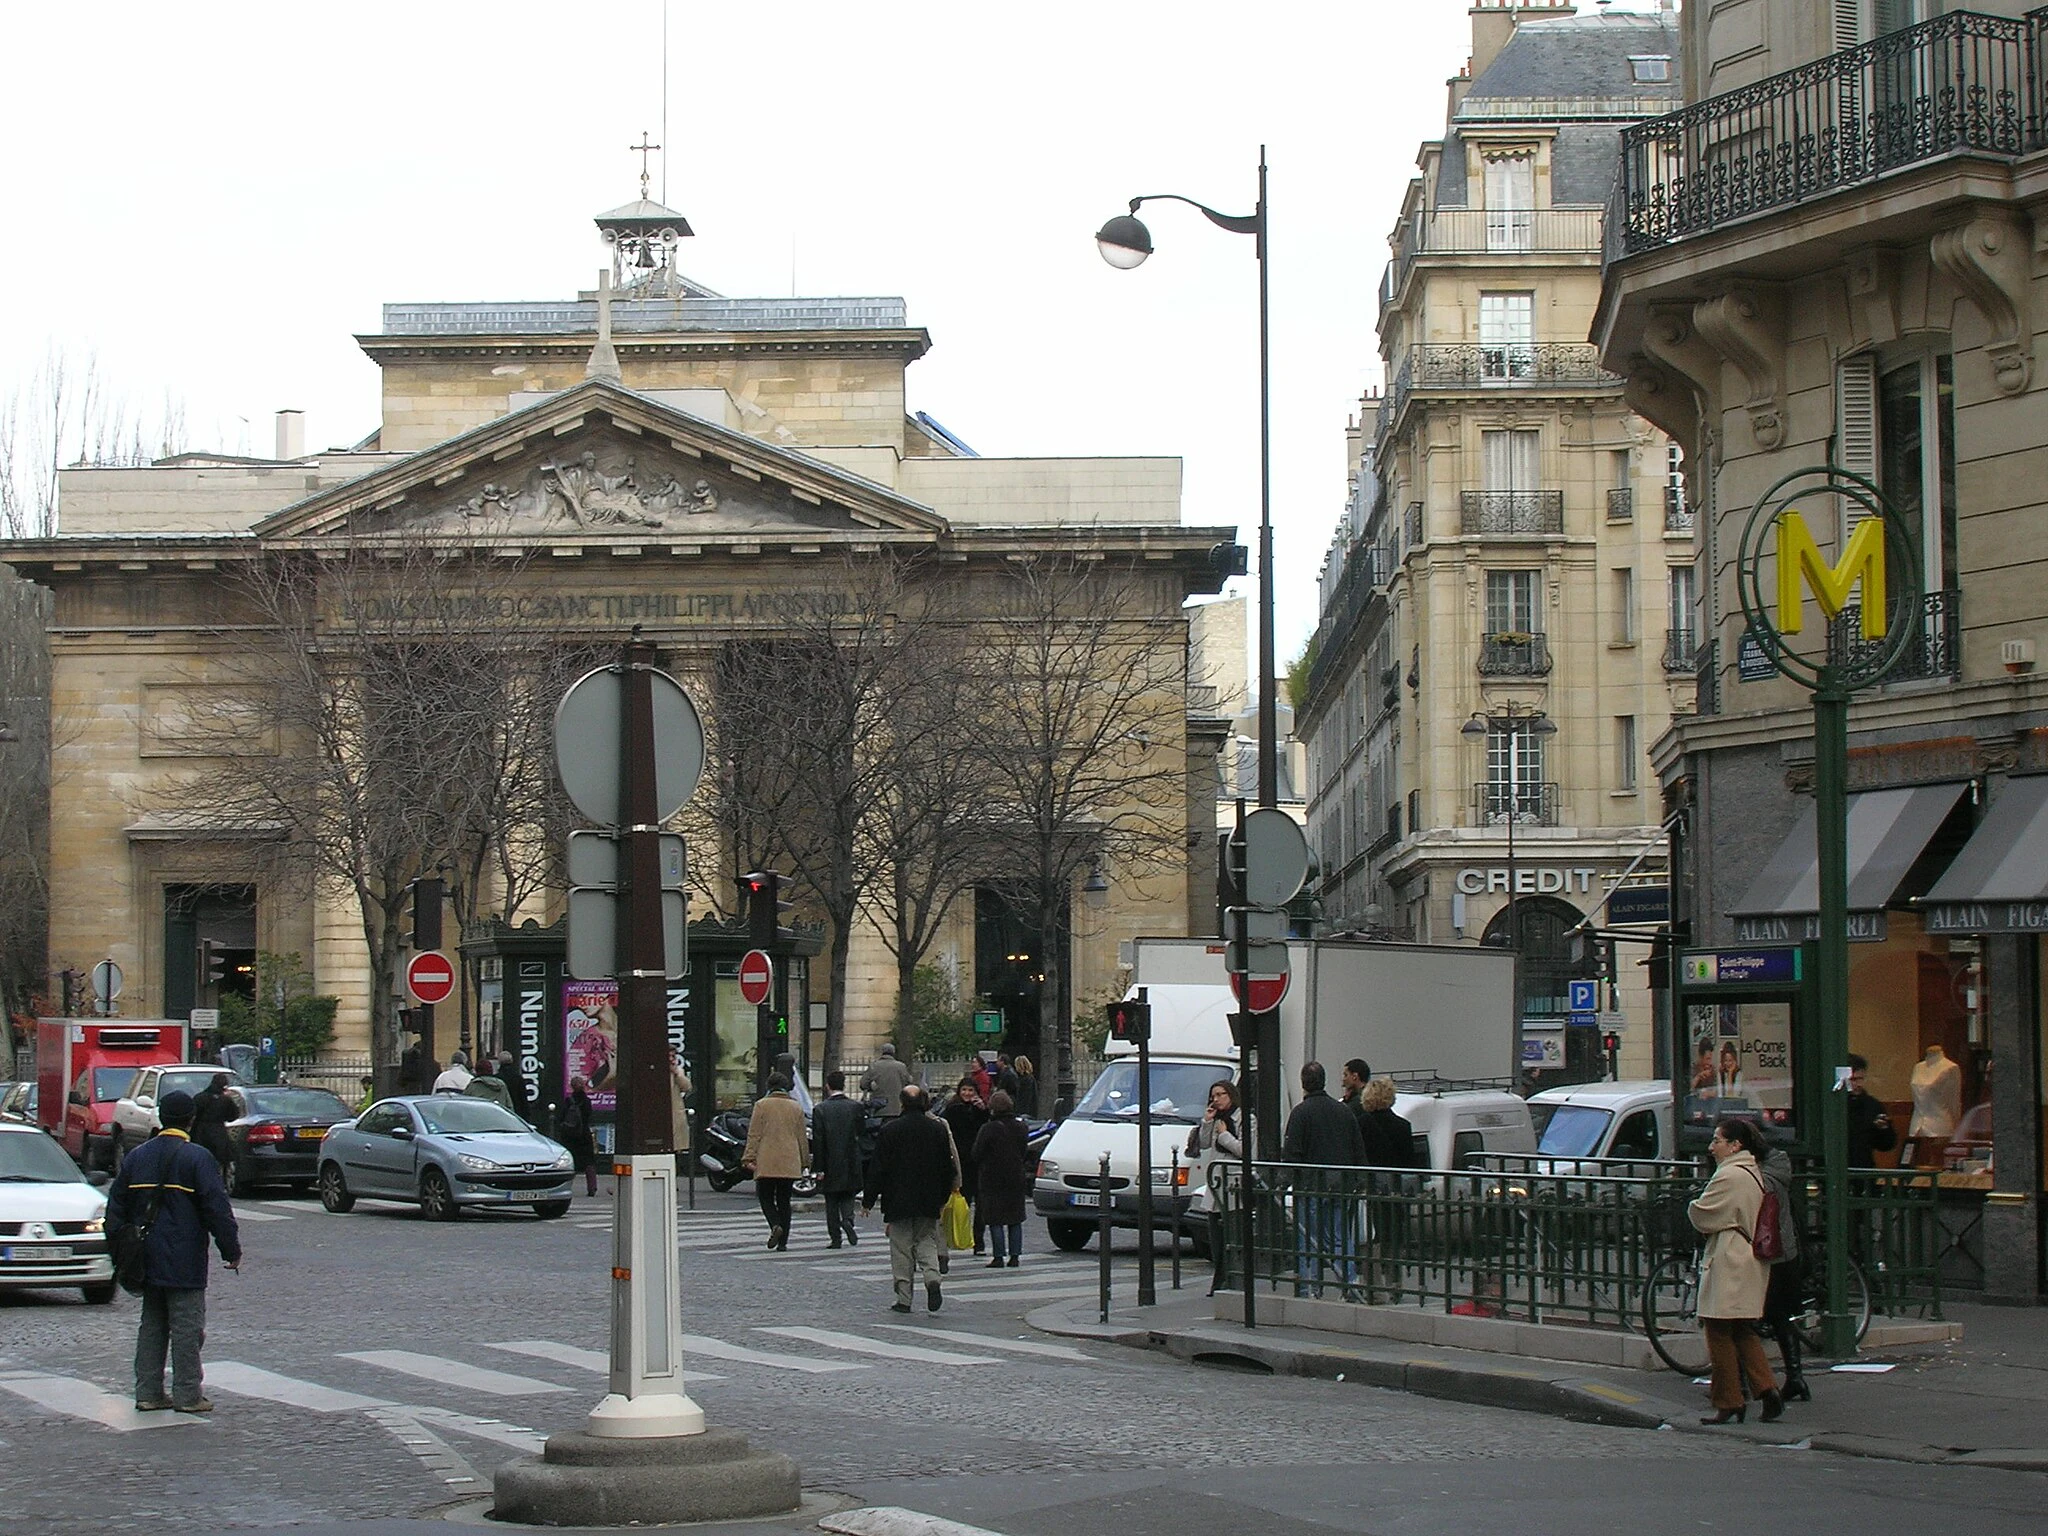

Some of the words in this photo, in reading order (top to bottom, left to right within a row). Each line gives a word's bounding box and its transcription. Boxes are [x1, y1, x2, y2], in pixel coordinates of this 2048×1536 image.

[1777, 511, 1887, 641] M
[1456, 868, 1596, 894] CREDIT
[1739, 917, 1789, 941] ALAIN
[1805, 914, 1878, 939] FIRET
[1931, 904, 1989, 929] ALAIN
[1576, 986, 1589, 1005] P
[520, 990, 545, 1101] Numéro
[1741, 1040, 1753, 1053] Le
[1753, 1039, 1787, 1053] Come
[1759, 1054, 1787, 1068] Back
